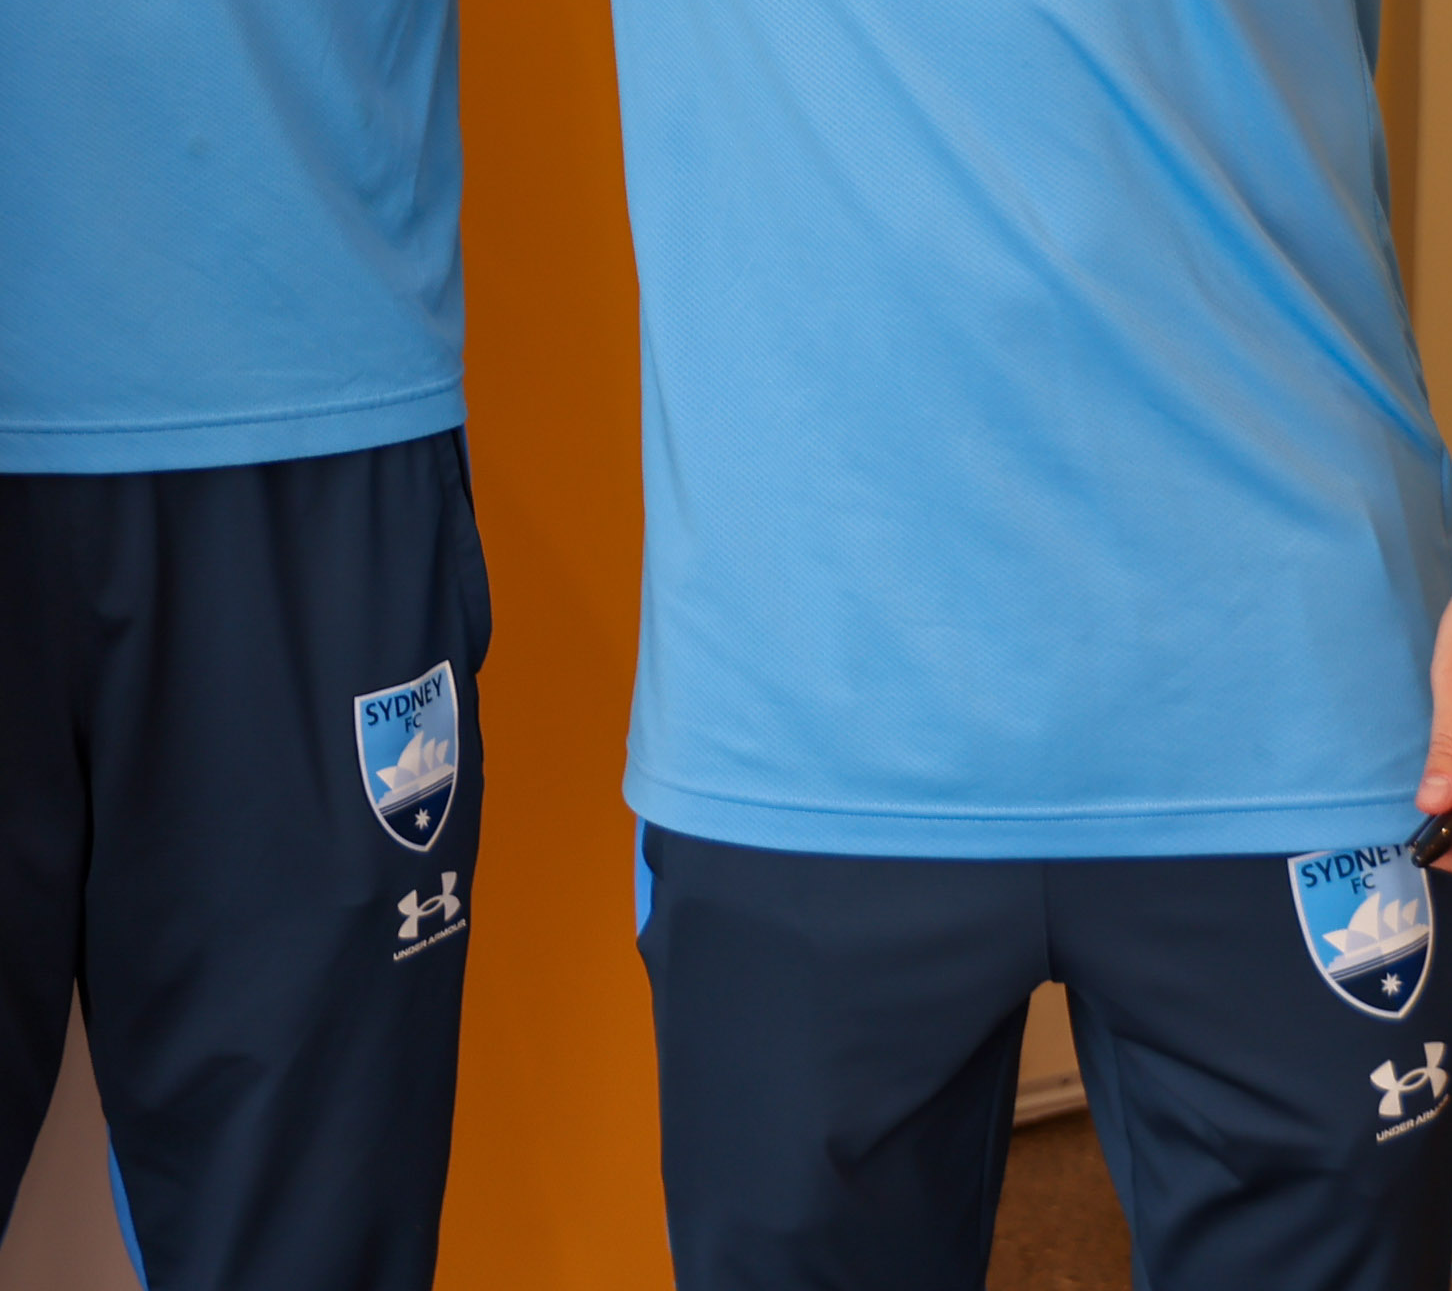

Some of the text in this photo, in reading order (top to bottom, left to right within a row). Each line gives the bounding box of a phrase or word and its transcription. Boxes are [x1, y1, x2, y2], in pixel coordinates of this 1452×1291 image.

[364, 672, 444, 727] SYDNEY
[403, 712, 422, 733] FC
[1350, 872, 1376, 895] FC
[392, 918, 467, 961] UNDER ARMOUR
[1375, 1118, 1415, 1143] UNDER
